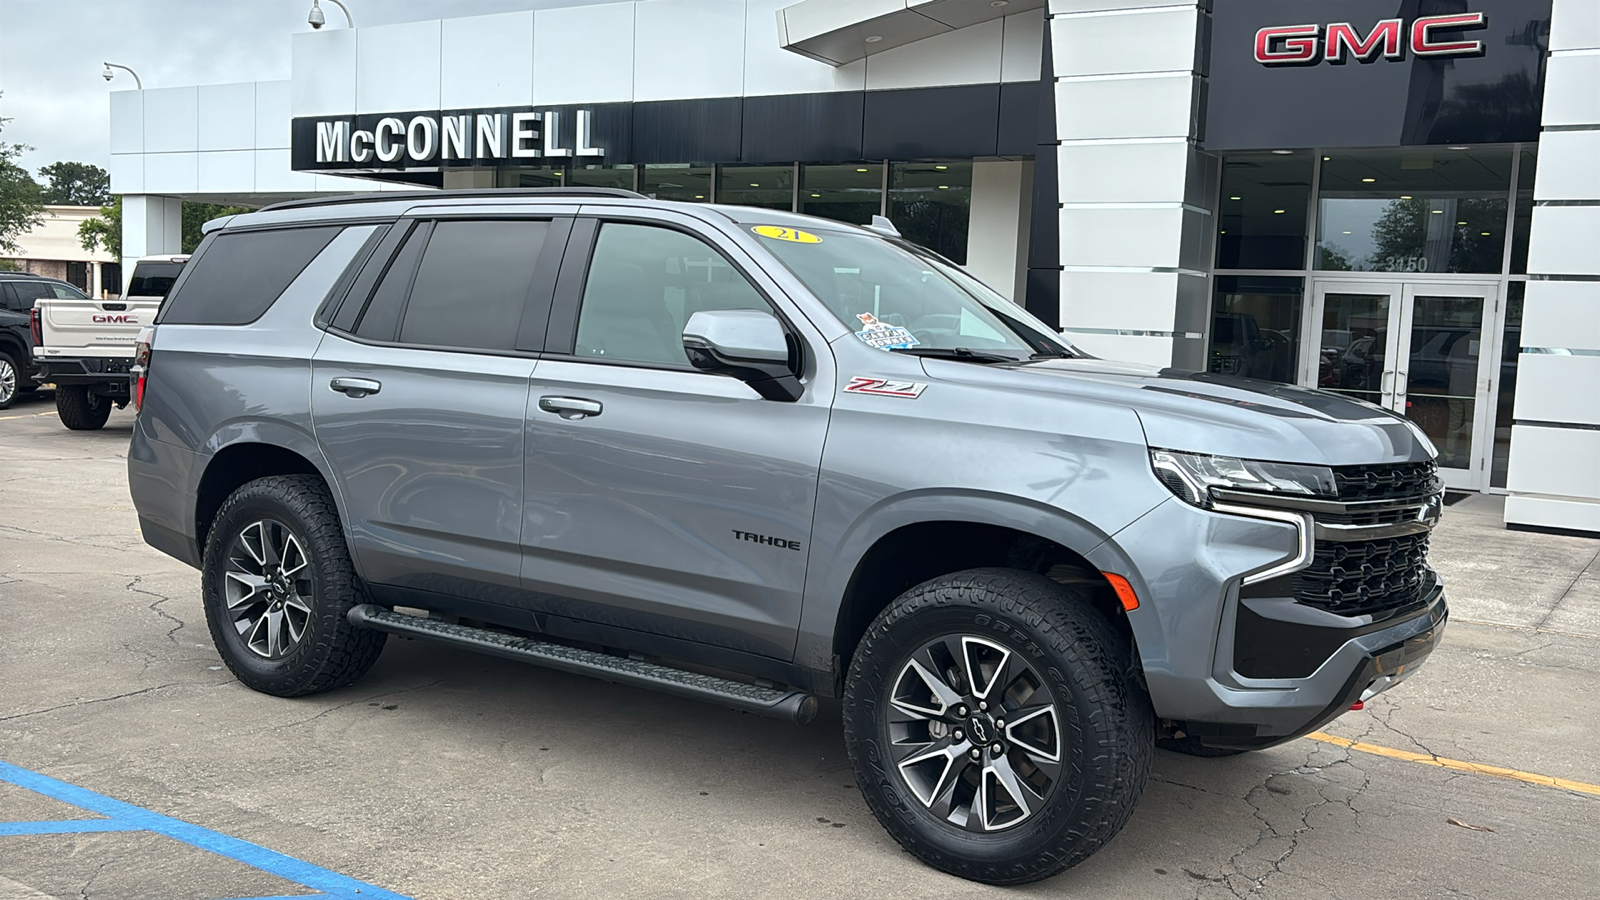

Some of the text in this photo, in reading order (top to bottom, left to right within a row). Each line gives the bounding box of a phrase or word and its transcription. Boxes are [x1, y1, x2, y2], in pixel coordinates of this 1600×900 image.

[1254, 12, 1484, 64] GMC
[774, 227, 800, 241] 21
[1385, 256, 1428, 272] 3150
[92, 315, 138, 324] GMC
[843, 376, 929, 400] Z71
[731, 529, 801, 551] TAHOE
[973, 613, 1046, 659] OPEN
